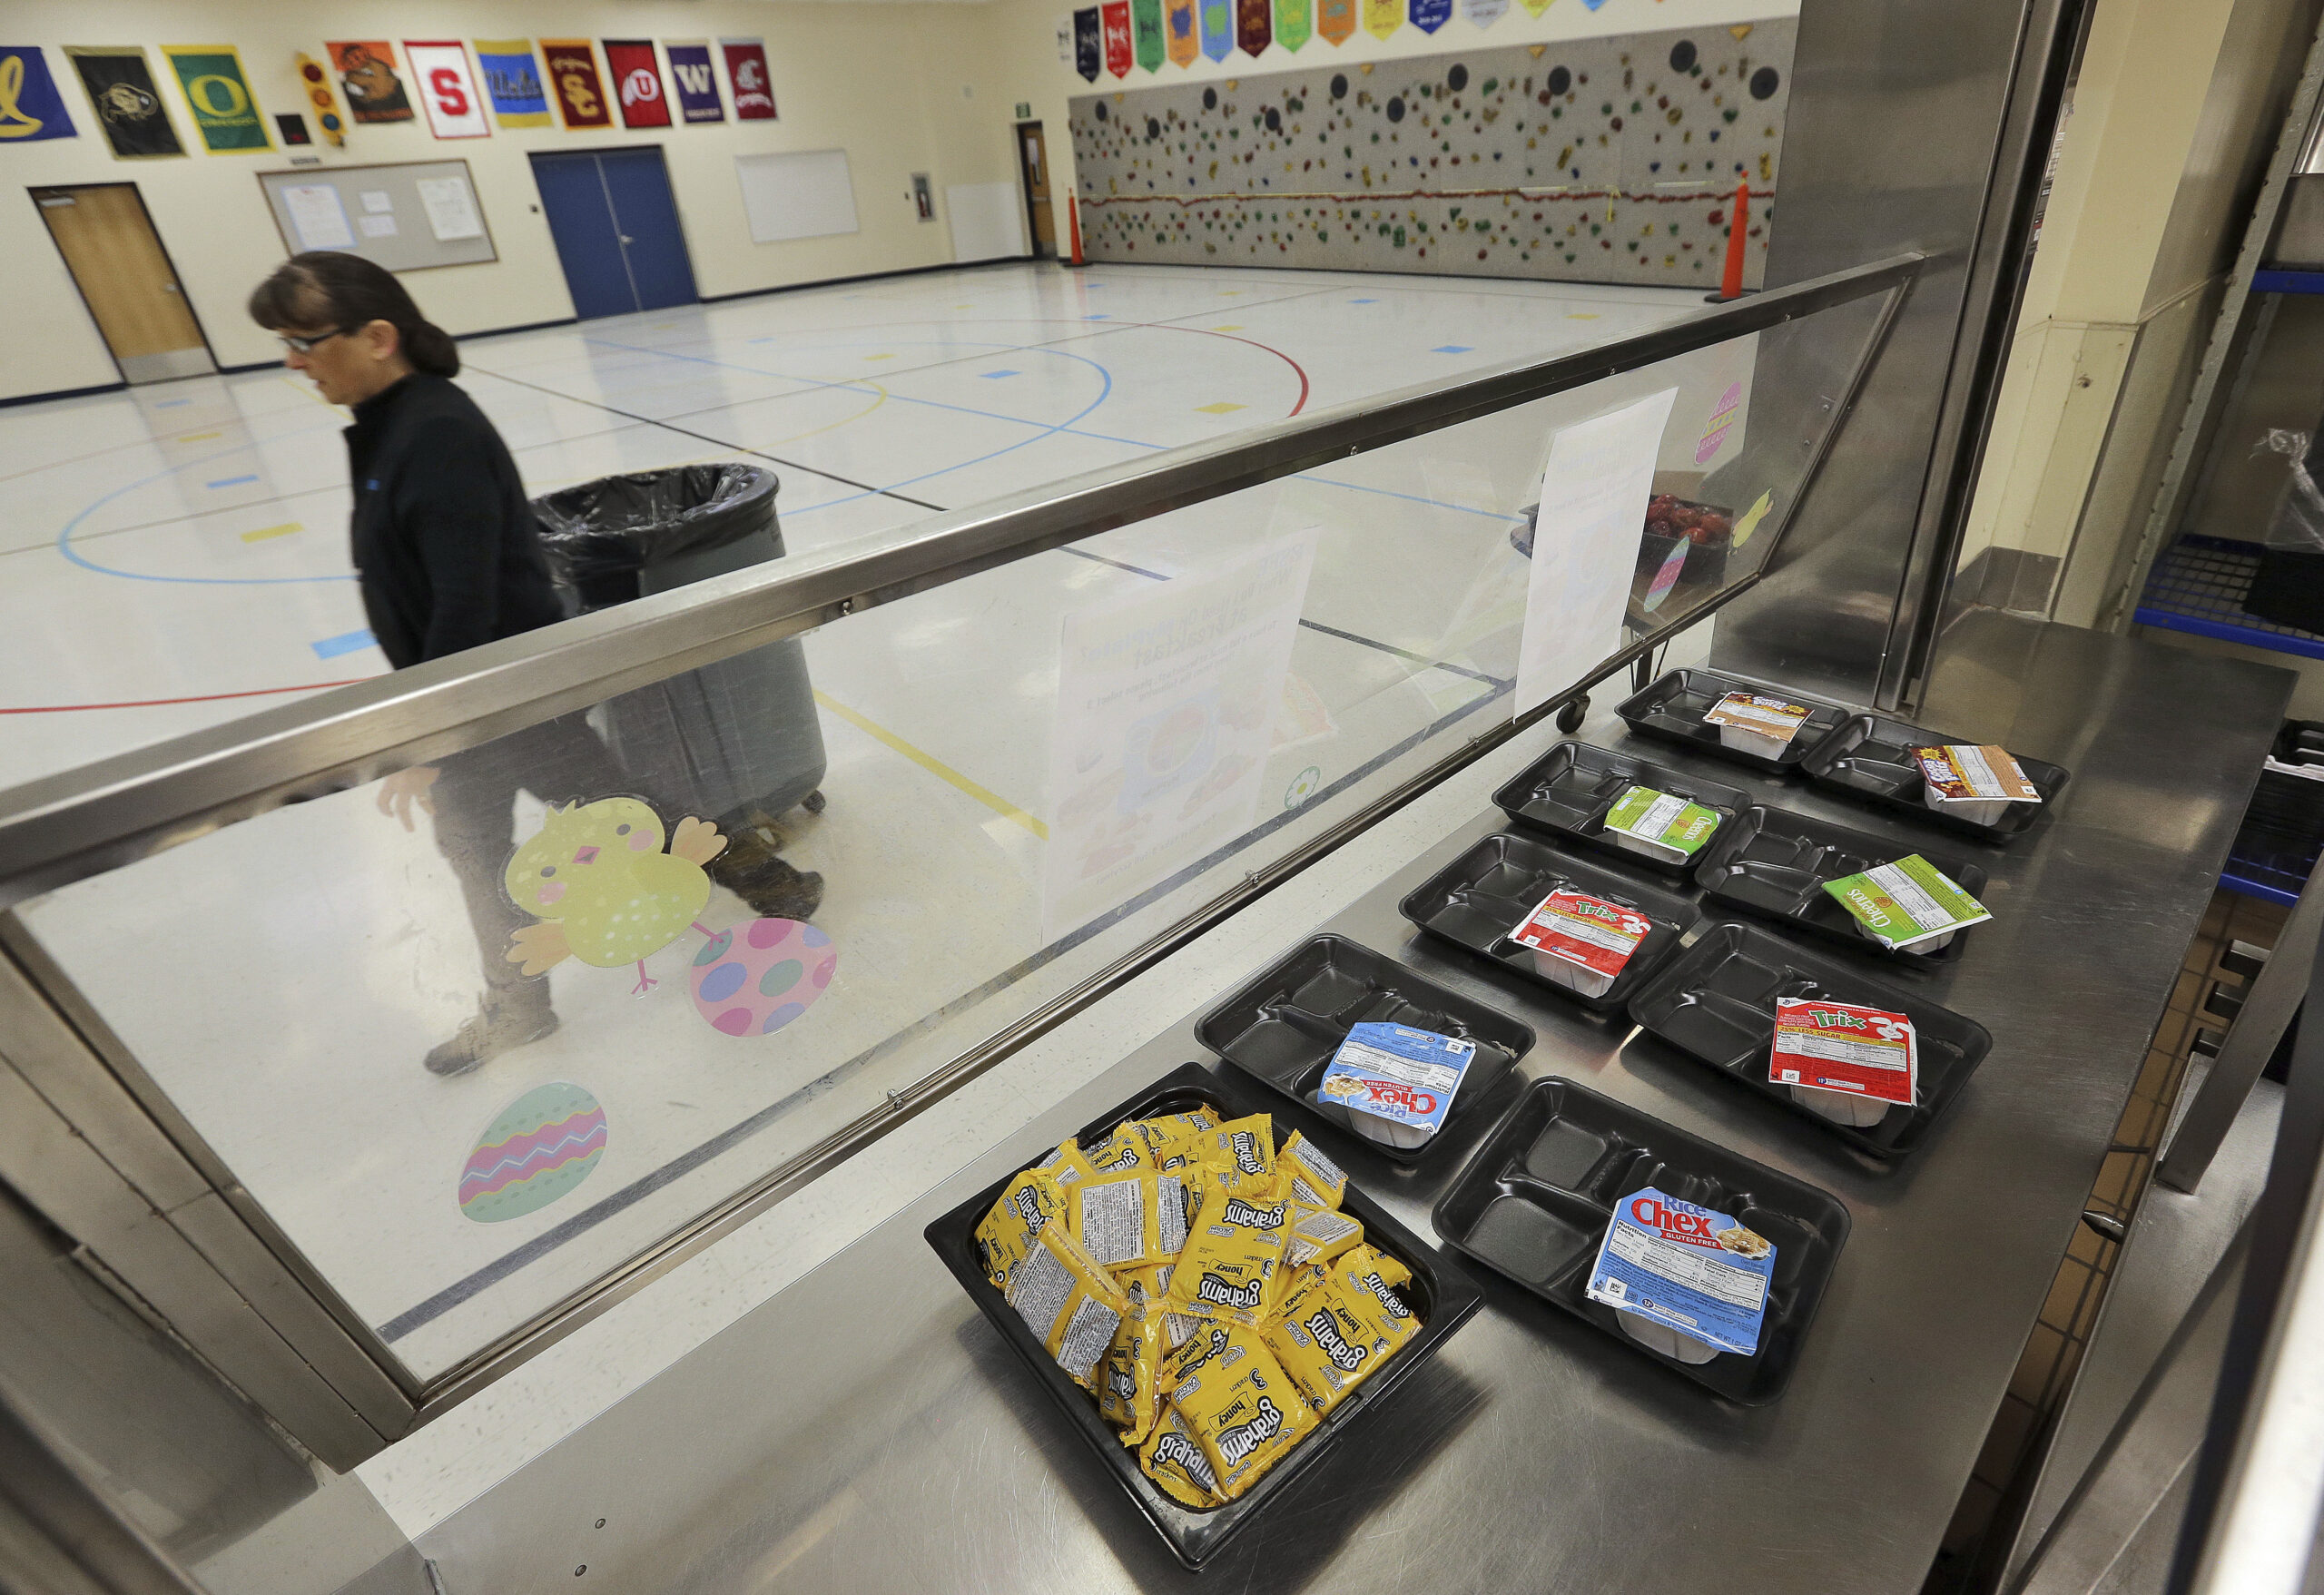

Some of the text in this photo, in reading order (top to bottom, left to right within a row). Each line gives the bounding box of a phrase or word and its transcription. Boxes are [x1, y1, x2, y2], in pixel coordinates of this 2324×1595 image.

[635, 75, 652, 96] U
[674, 64, 711, 94] W
[429, 67, 468, 116] S
[1576, 901, 1620, 921] Trix
[1847, 888, 1891, 928] Cheerios
[1809, 1010, 1867, 1029] Trix
[1817, 1030, 1841, 1039] SUGAR
[1383, 1084, 1408, 1092] GLUTEN
[1365, 1088, 1437, 1115] Chex
[1370, 1102, 1408, 1118] Rice
[1232, 1132, 1265, 1174] grahams
[1223, 1206, 1285, 1227] grahams
[1664, 1195, 1707, 1217] Rice
[1631, 1198, 1714, 1237] Chex
[1617, 1226, 1634, 1238] Facts
[1619, 1221, 1647, 1238] Nutrition
[1666, 1232, 1718, 1247] GLUTEN FREE
[1215, 1265, 1243, 1275] honey
[1261, 1258, 1275, 1278] 3
[1198, 1281, 1261, 1305] grahams
[1285, 1289, 1307, 1308] honey
[1336, 1307, 1360, 1334] honey
[1178, 1340, 1201, 1364] honey
[1306, 1314, 1365, 1369] grahams
[1175, 1376, 1198, 1401] CALCIUM
[1229, 1375, 1249, 1393] crackers
[1250, 1369, 1267, 1390] 3
[1219, 1400, 1246, 1427] honey
[1221, 1399, 1280, 1466] grahams
[1157, 1469, 1177, 1482] crackers
